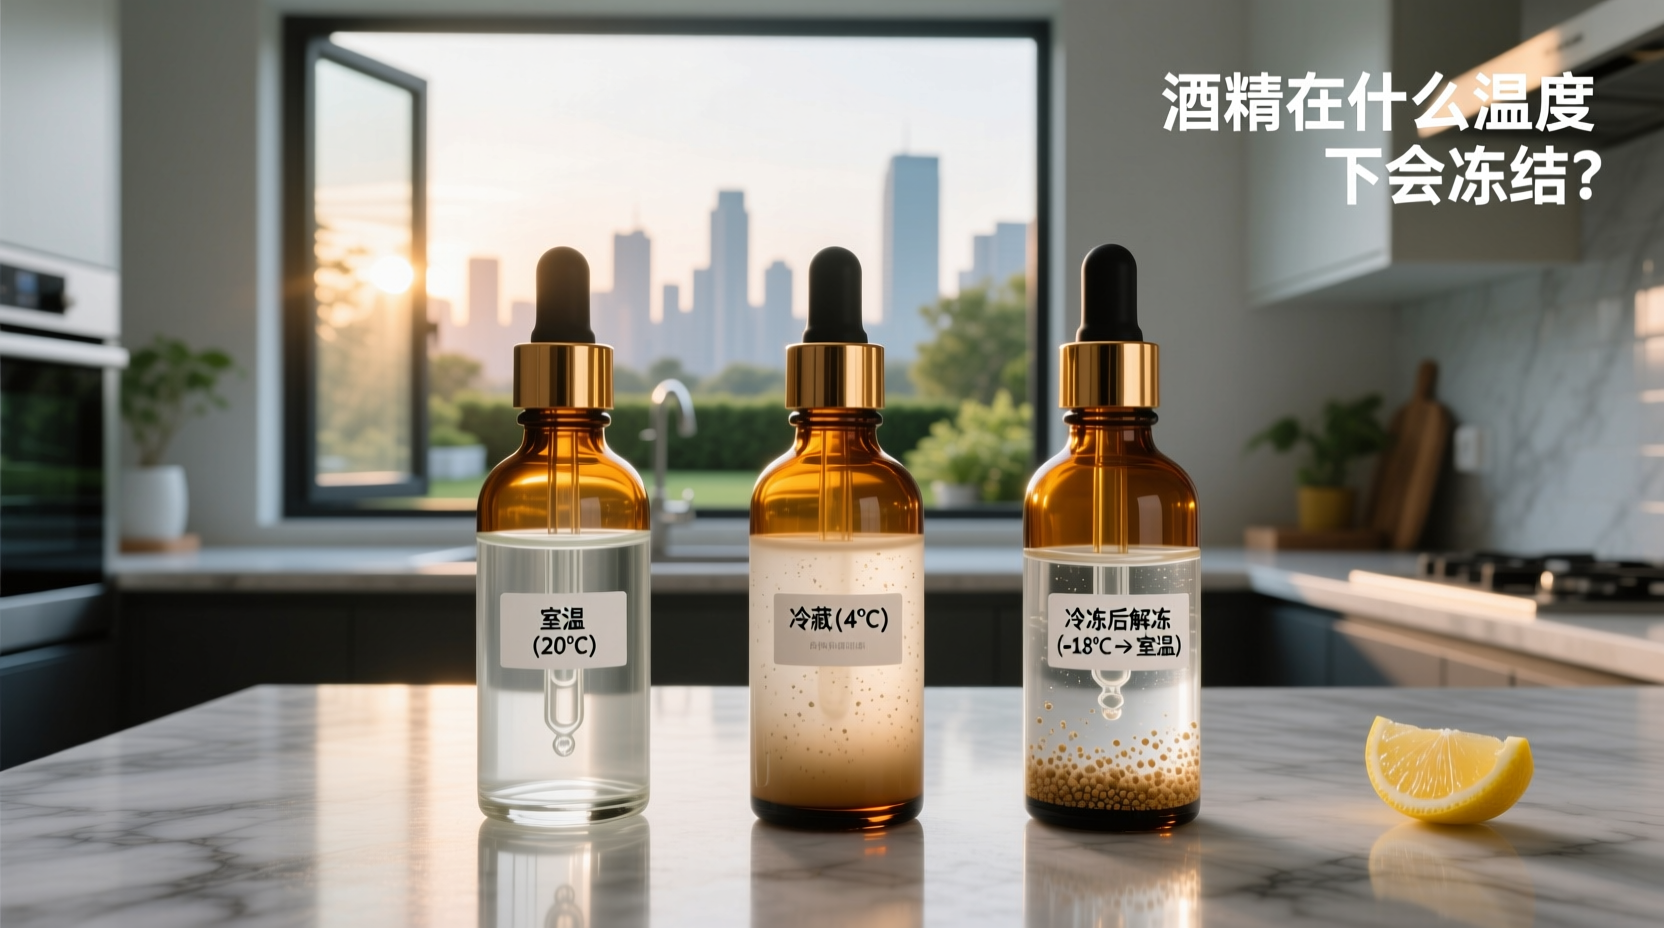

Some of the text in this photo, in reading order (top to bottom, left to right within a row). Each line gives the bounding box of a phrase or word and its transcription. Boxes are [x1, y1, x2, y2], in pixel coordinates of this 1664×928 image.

[539, 606, 586, 631] 室温
[1064, 606, 1171, 631] 冷冻后解冻
[532, 634, 597, 659] (20°C)
